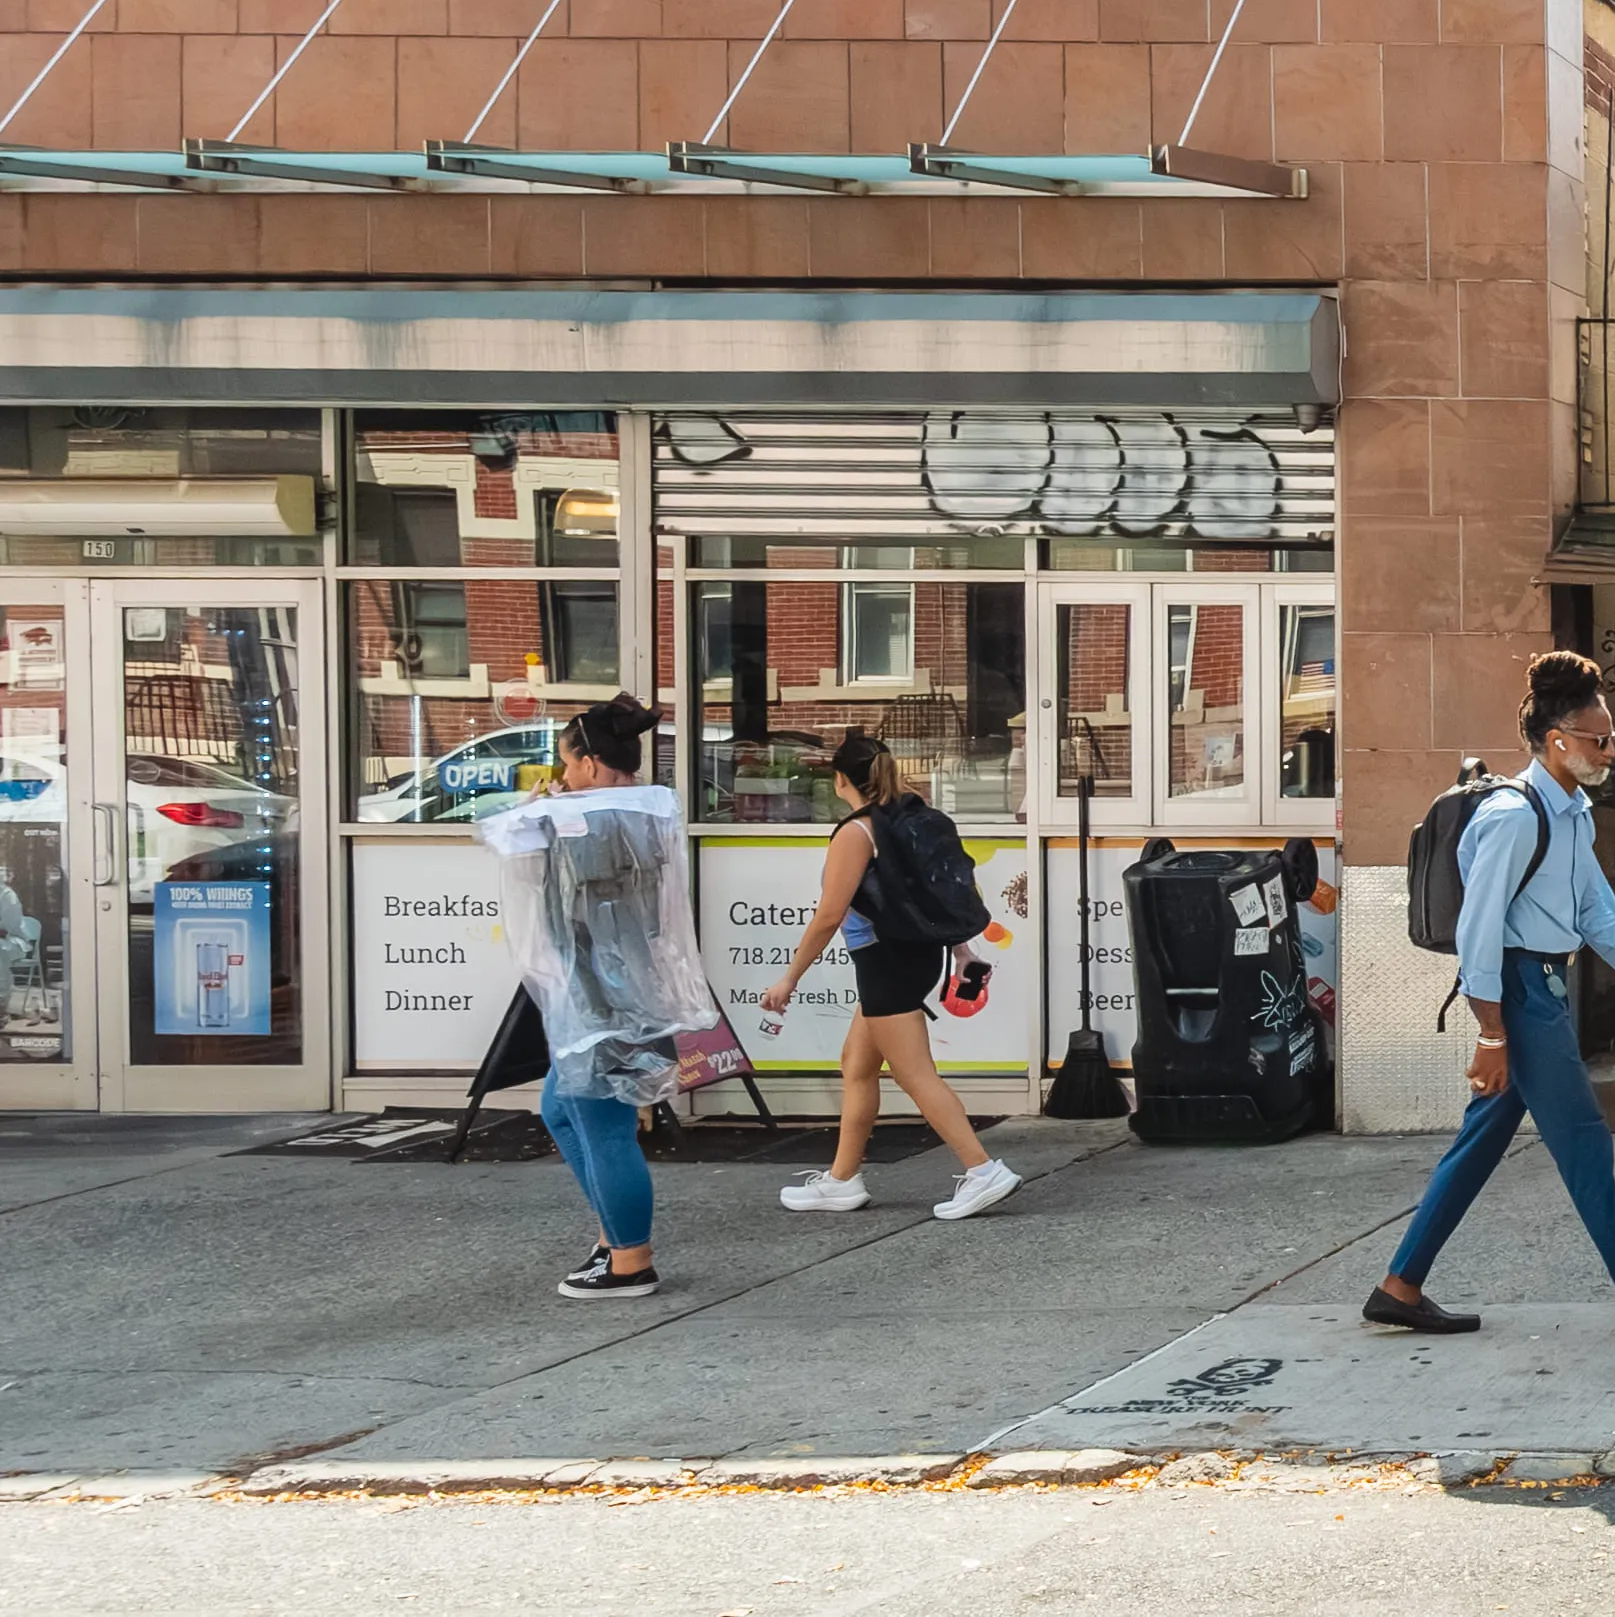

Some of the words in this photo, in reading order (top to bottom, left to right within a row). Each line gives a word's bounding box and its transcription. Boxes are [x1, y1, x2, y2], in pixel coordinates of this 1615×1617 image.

[88, 542, 112, 557] 150
[445, 763, 510, 788] OPEN
[170, 887, 203, 900] 100%
[384, 895, 499, 917] Breakfas
[729, 900, 817, 926] Cateri
[1077, 897, 1123, 922] Spe
[384, 942, 467, 964] Lunch
[1077, 943, 1134, 964] Dess
[385, 989, 473, 1011] Dinner
[1065, 1406, 1201, 1414] TREASURE
